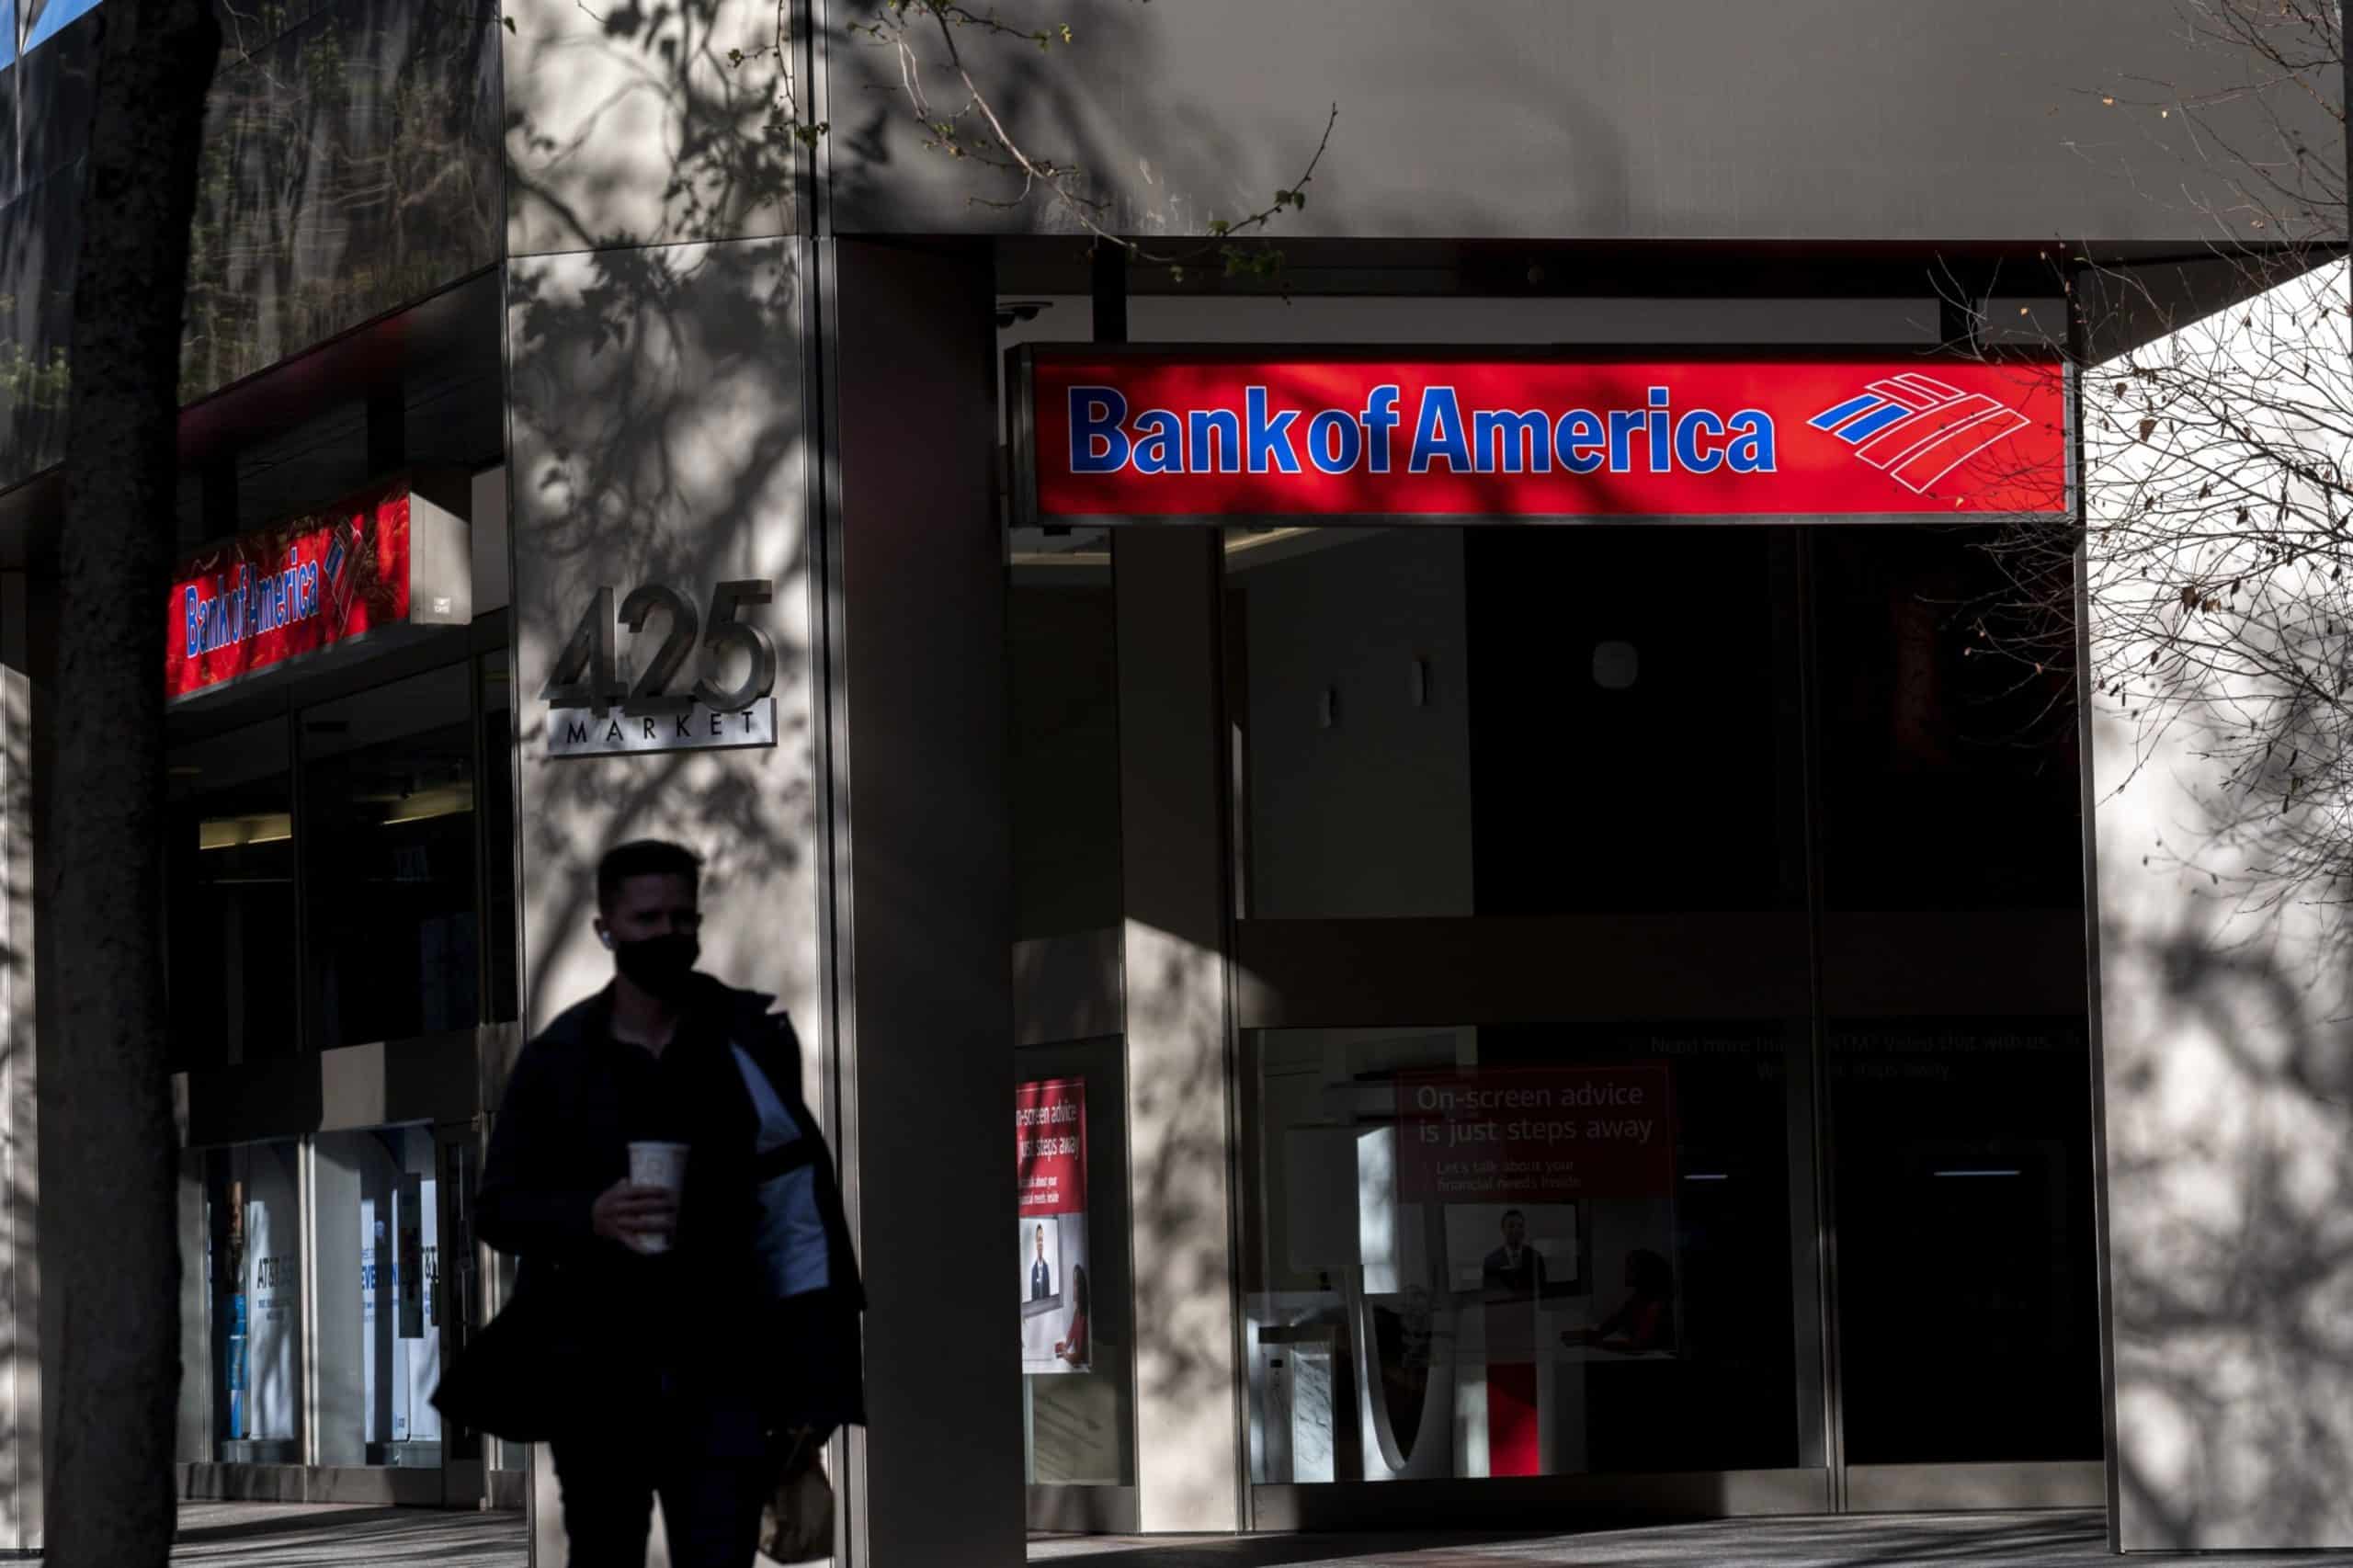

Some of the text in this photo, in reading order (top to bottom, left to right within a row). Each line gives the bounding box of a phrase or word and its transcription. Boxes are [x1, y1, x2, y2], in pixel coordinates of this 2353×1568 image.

[1067, 384, 1777, 474] Bank of America
[185, 546, 319, 658] Bank of America
[539, 579, 776, 719] 425
[566, 711, 754, 744] MARKET
[1051, 1098, 1077, 1123] advice
[1416, 1080, 1644, 1110] On-screen advice
[1036, 1134, 1058, 1162] steps
[1059, 1134, 1080, 1161] away
[1419, 1117, 1654, 1148] is just steps away
[1501, 1158, 1543, 1174] about
[1546, 1160, 1574, 1176] your
